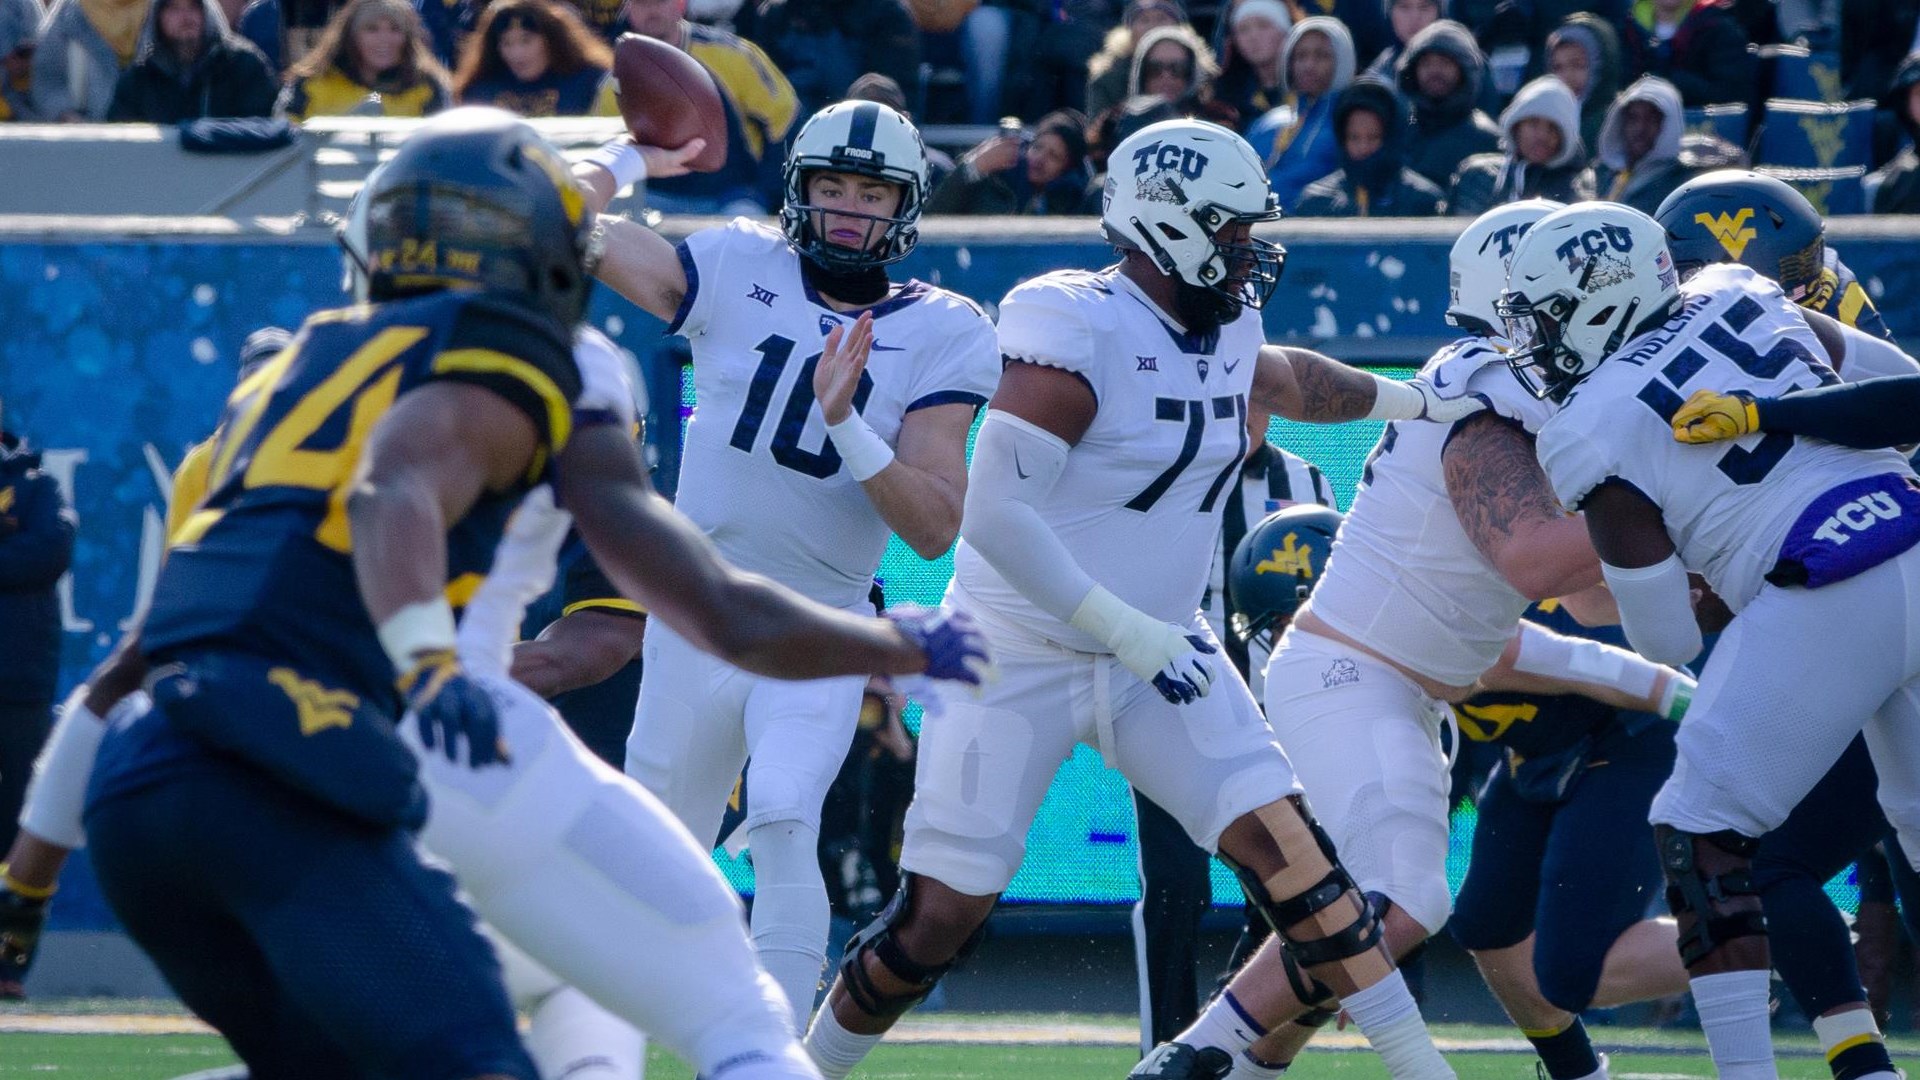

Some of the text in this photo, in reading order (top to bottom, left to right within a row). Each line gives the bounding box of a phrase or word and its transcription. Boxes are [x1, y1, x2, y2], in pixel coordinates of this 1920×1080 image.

[844, 147, 873, 160] FROGS
[1132, 143, 1209, 182] TCU
[1556, 226, 1634, 275] TCU
[747, 284, 779, 308] XII
[1136, 356, 1159, 372] XII
[729, 333, 875, 480] 10
[1123, 392, 1248, 513] 77
[1812, 491, 1902, 545] TCU
